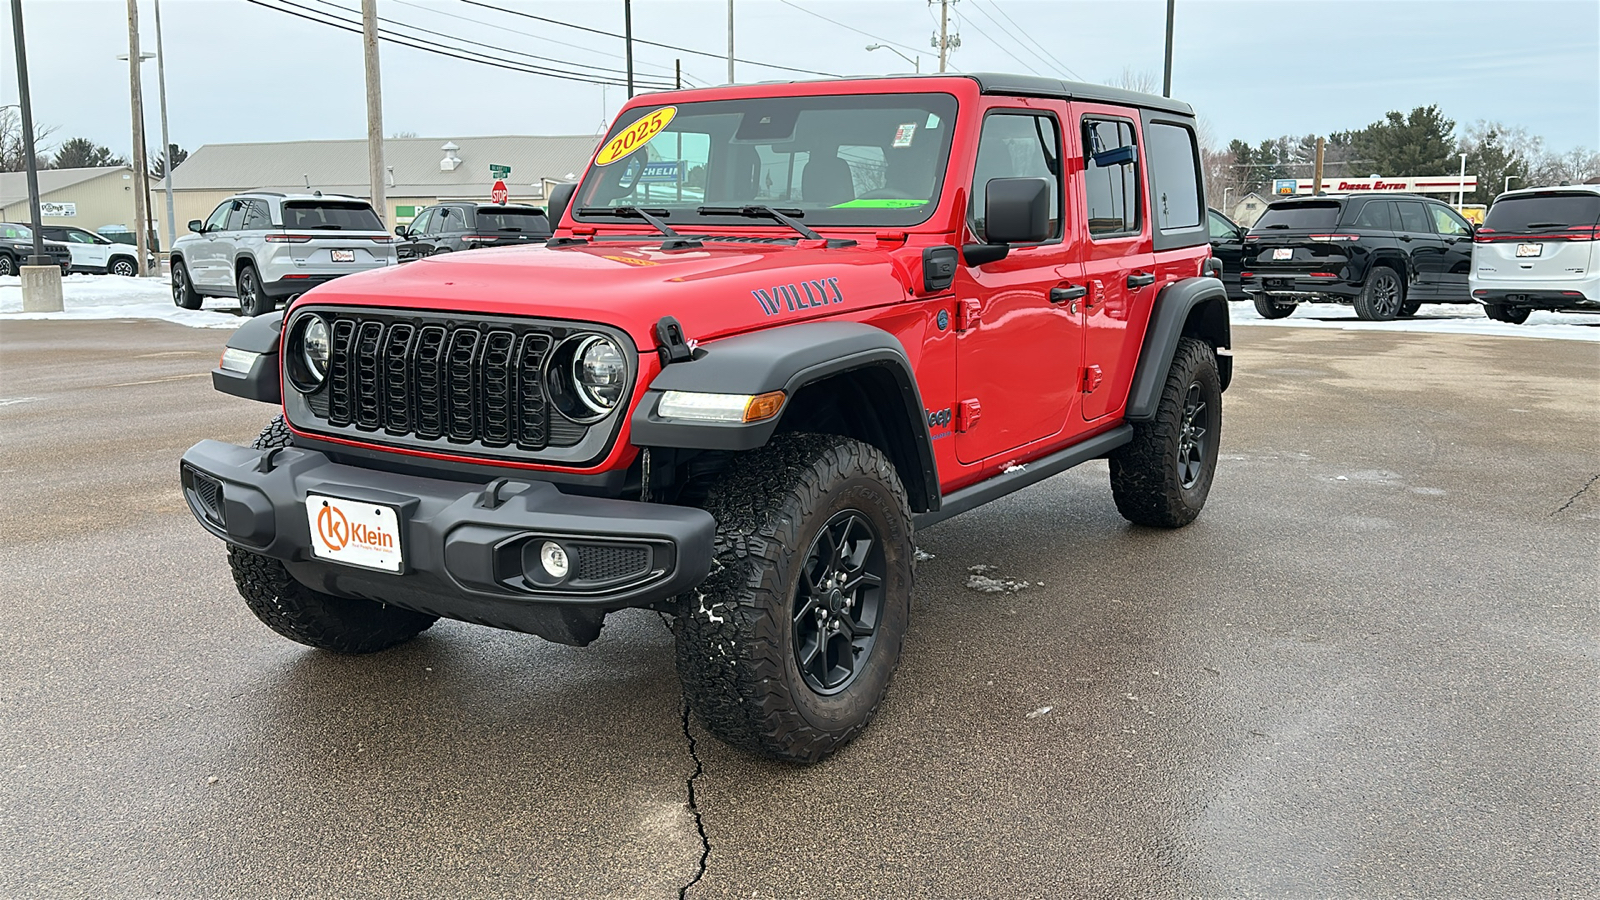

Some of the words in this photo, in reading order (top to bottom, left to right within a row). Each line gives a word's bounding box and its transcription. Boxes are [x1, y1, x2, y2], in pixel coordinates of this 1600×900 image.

[610, 111, 662, 160] 2025
[626, 167, 679, 176] MCHELIN
[492, 189, 507, 202] STOP
[751, 276, 843, 316] WILLYS
[350, 521, 394, 548] Klein
